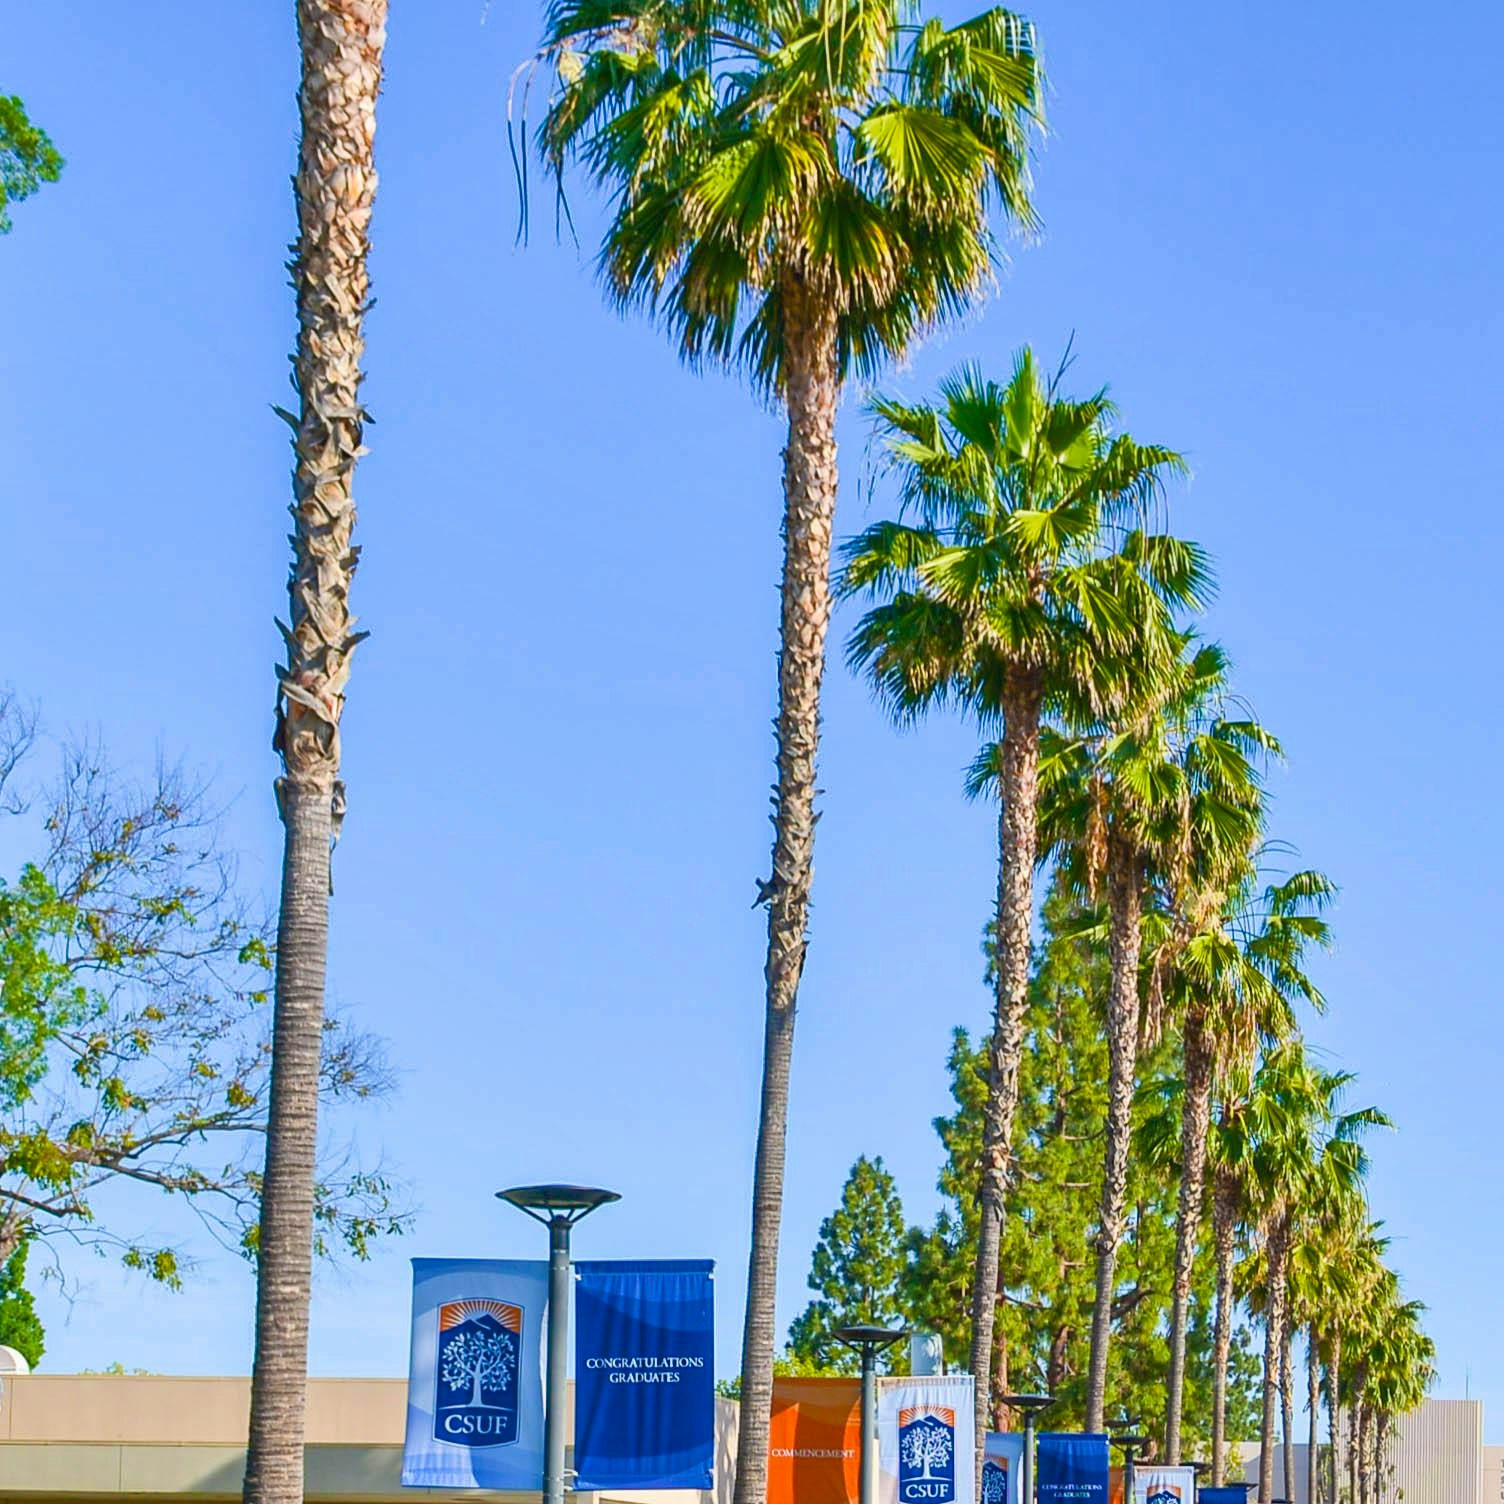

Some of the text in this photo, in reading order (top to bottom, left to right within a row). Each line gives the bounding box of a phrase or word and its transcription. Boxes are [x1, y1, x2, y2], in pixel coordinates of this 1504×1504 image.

[586, 1357, 704, 1369] CONGRATULATIONS
[609, 1372, 680, 1383] GRADUATES
[444, 1414, 508, 1434] CSUF
[771, 1448, 855, 1458] COMMENCEMENT
[905, 1483, 949, 1498] CSUF
